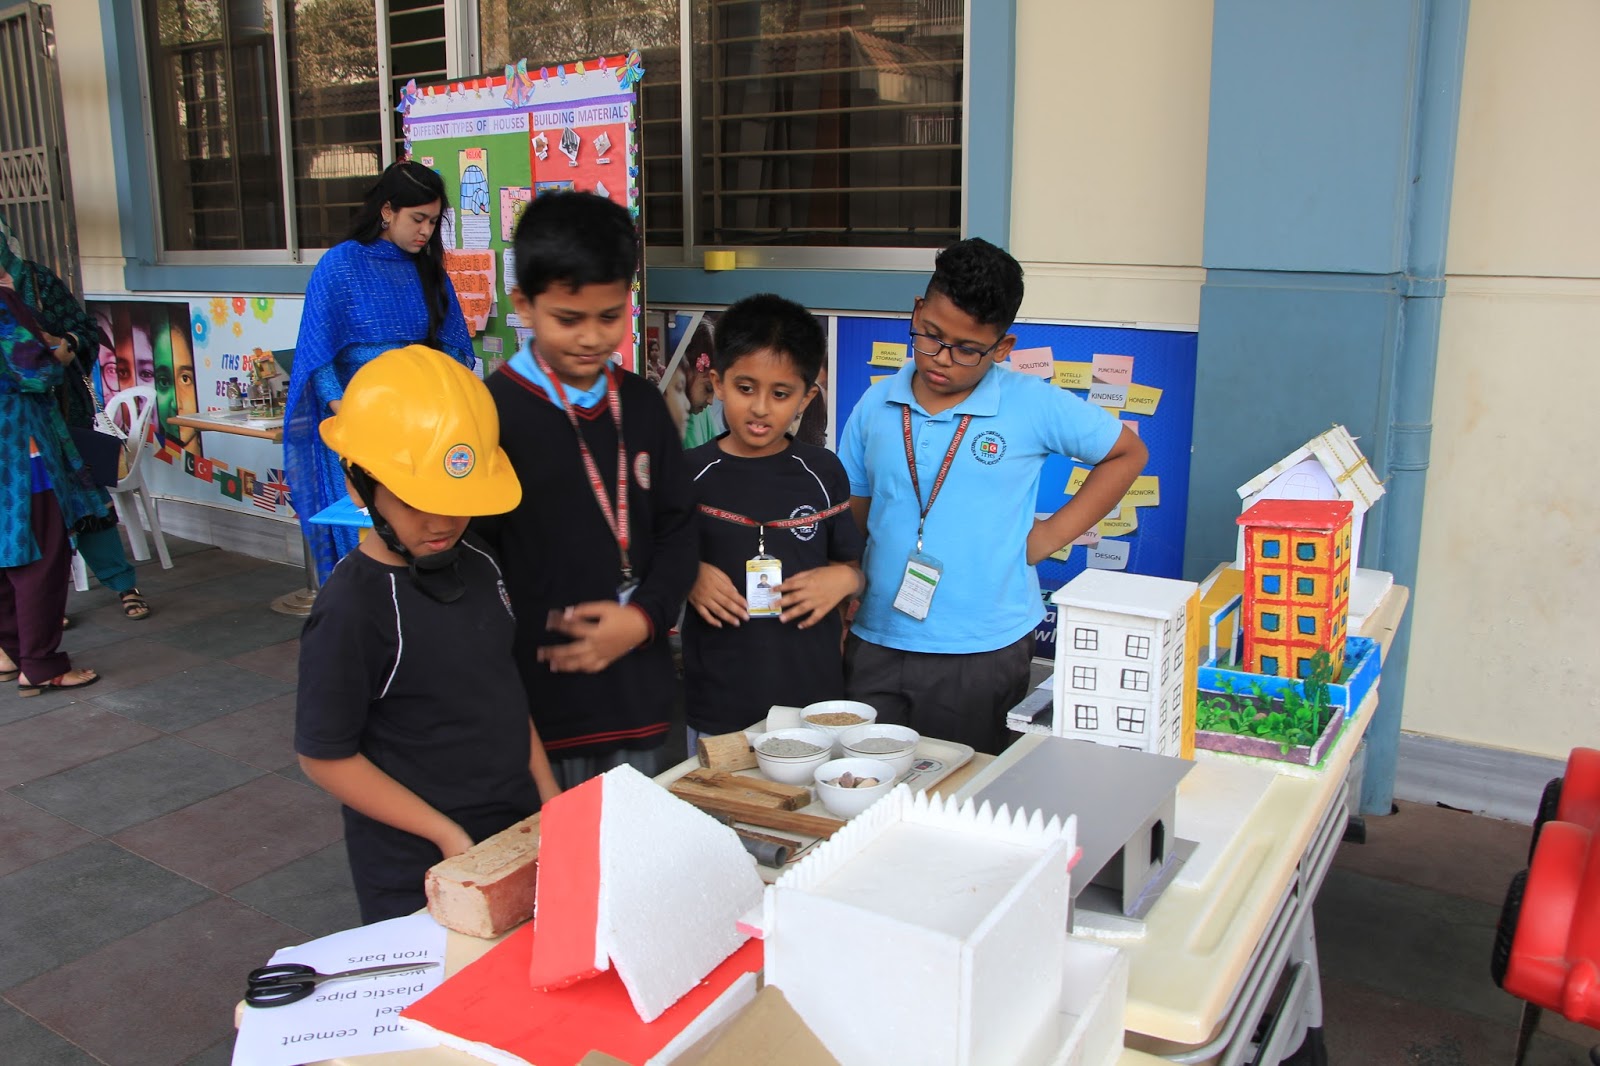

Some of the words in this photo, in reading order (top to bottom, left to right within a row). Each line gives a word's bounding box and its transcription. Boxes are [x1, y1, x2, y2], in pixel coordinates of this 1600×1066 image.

[534, 111, 574, 126] BUILDING
[578, 105, 629, 122] MATERIALS
[413, 124, 450, 137] DIFFERENT
[452, 121, 474, 134] TYPES
[476, 119, 488, 131] OF
[493, 117, 525, 130] HOUSES
[221, 354, 240, 371] ITHS
[1018, 361, 1050, 370] SOLUTION
[1097, 367, 1129, 375] PUNCTUALITY
[1091, 392, 1123, 402] KINDNESS
[1128, 397, 1155, 405] HONESTY
[960, 415, 970, 431] HOP
[701, 505, 718, 517] HOPE
[720, 511, 746, 525] SCHOOL
[777, 513, 822, 528] INTERNATIONAL
[1094, 552, 1122, 561] DESIGN
[347, 952, 386, 964] bars
[392, 950, 428, 960] iron
[315, 988, 357, 1003] pipe
[362, 982, 425, 999] plastic
[375, 1005, 406, 1018] eel
[280, 1027, 358, 1046] cement
